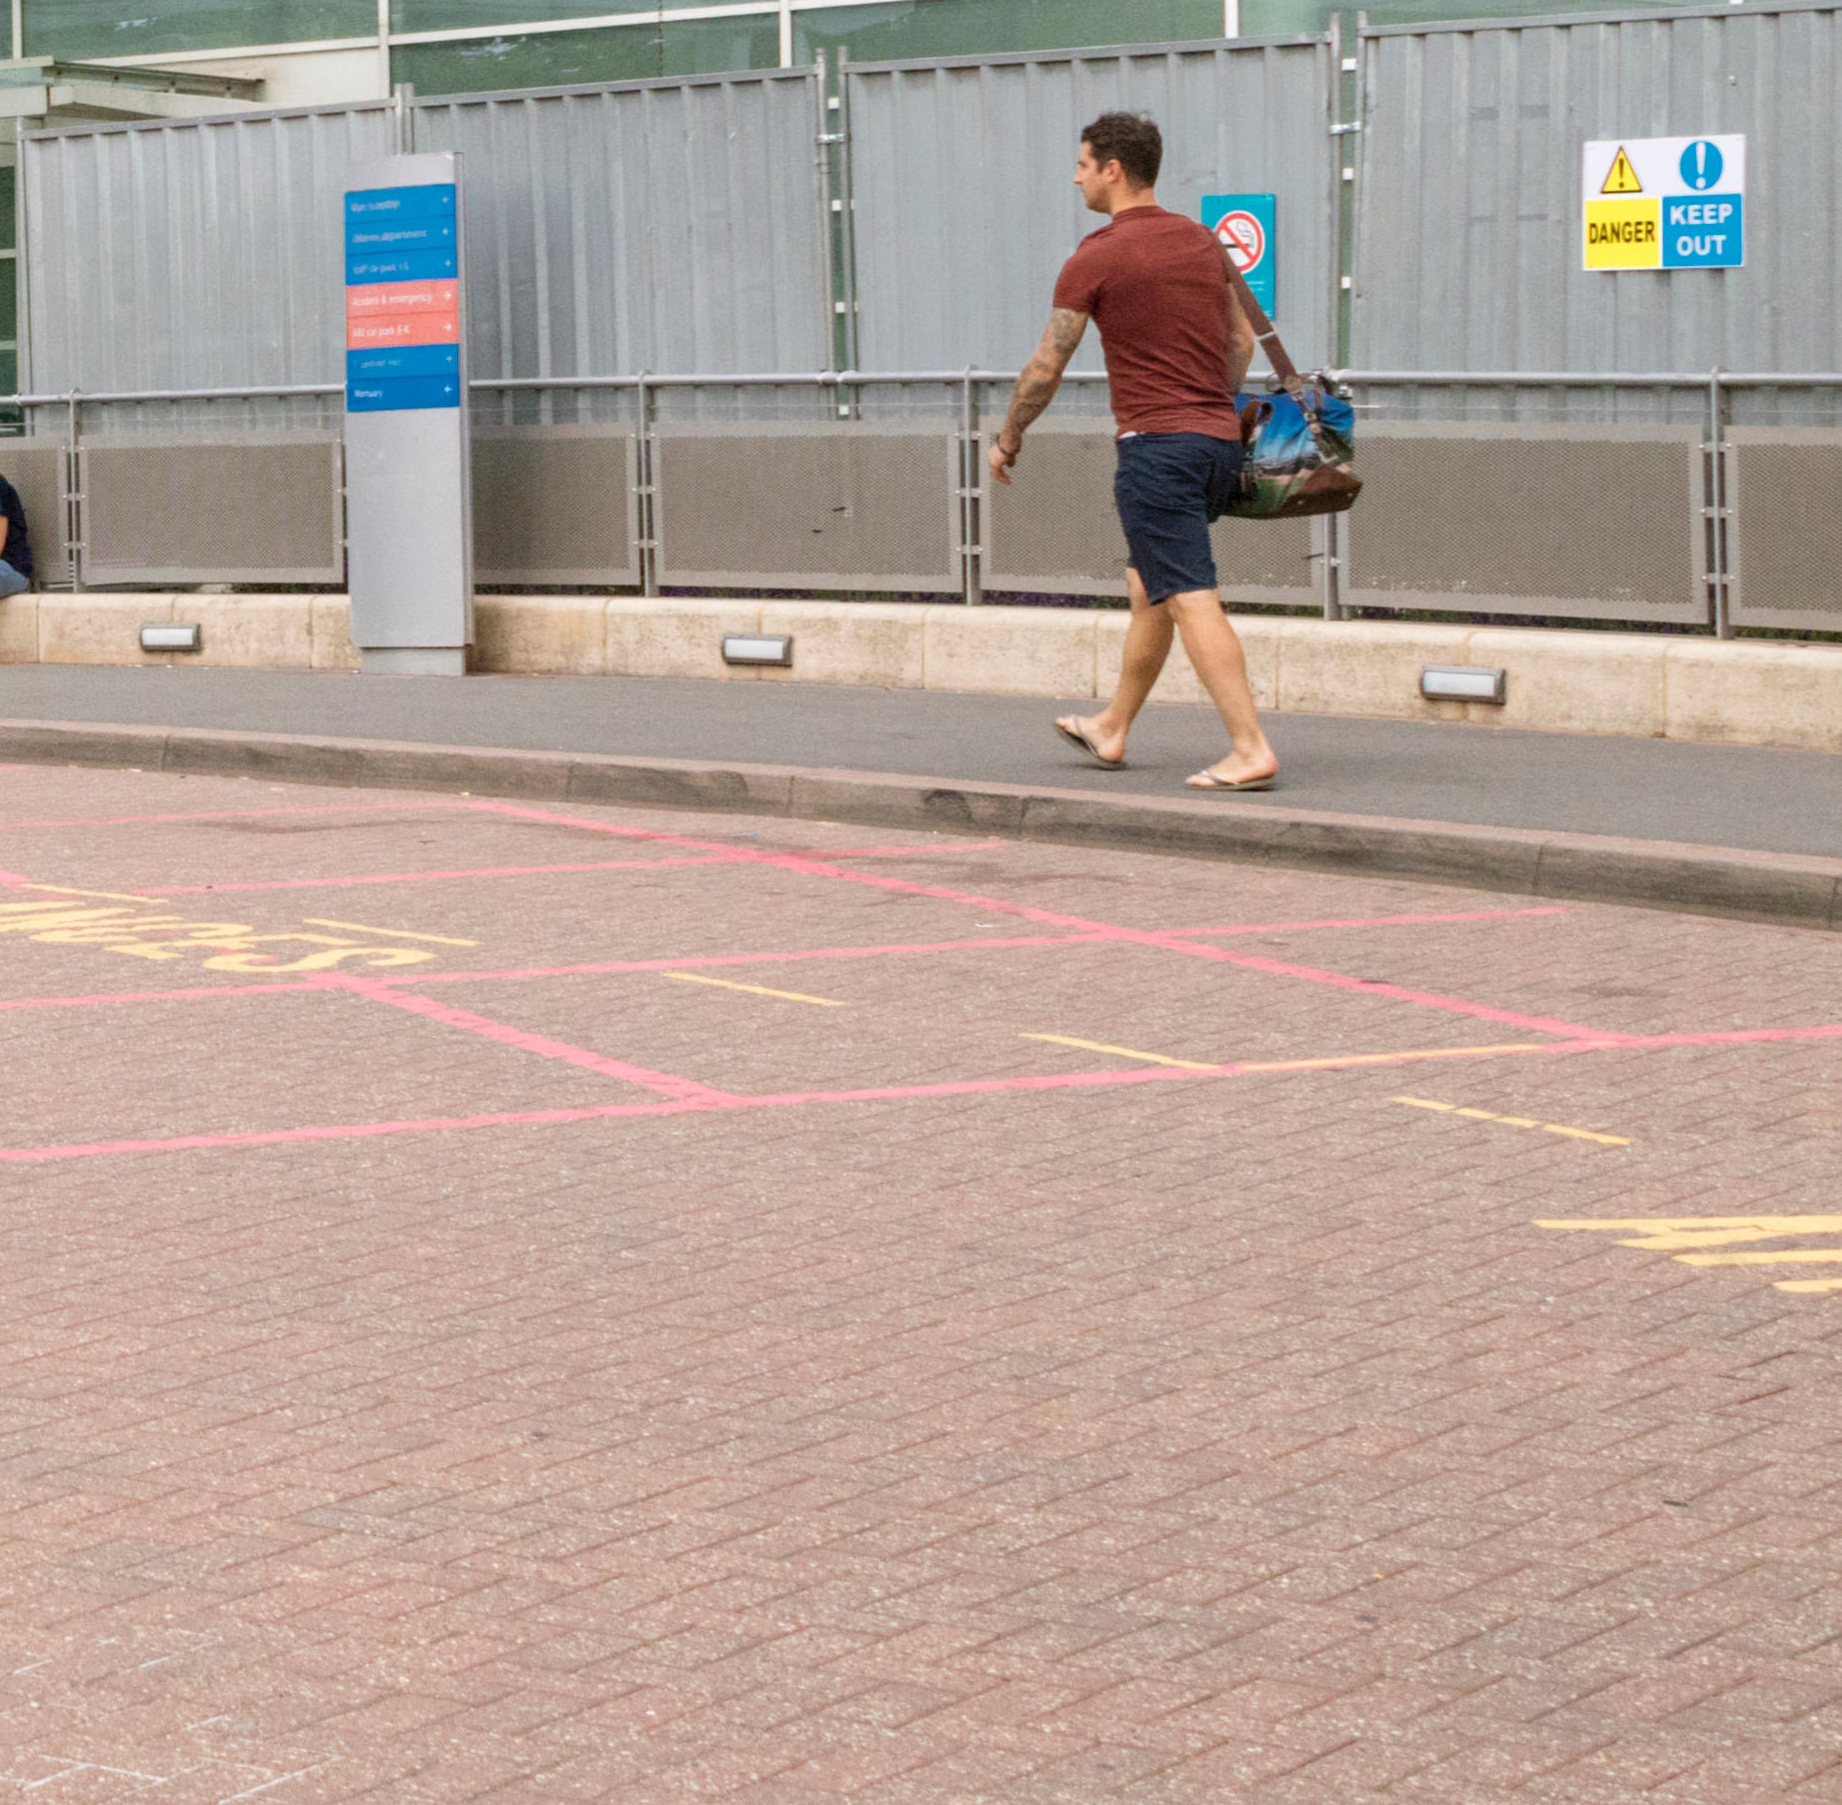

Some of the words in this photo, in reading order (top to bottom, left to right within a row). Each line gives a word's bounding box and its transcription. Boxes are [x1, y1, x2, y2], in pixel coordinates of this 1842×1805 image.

[1670, 204, 1733, 225] KEEP
[1589, 221, 1656, 244] DANGER
[1676, 235, 1727, 256] OUT
